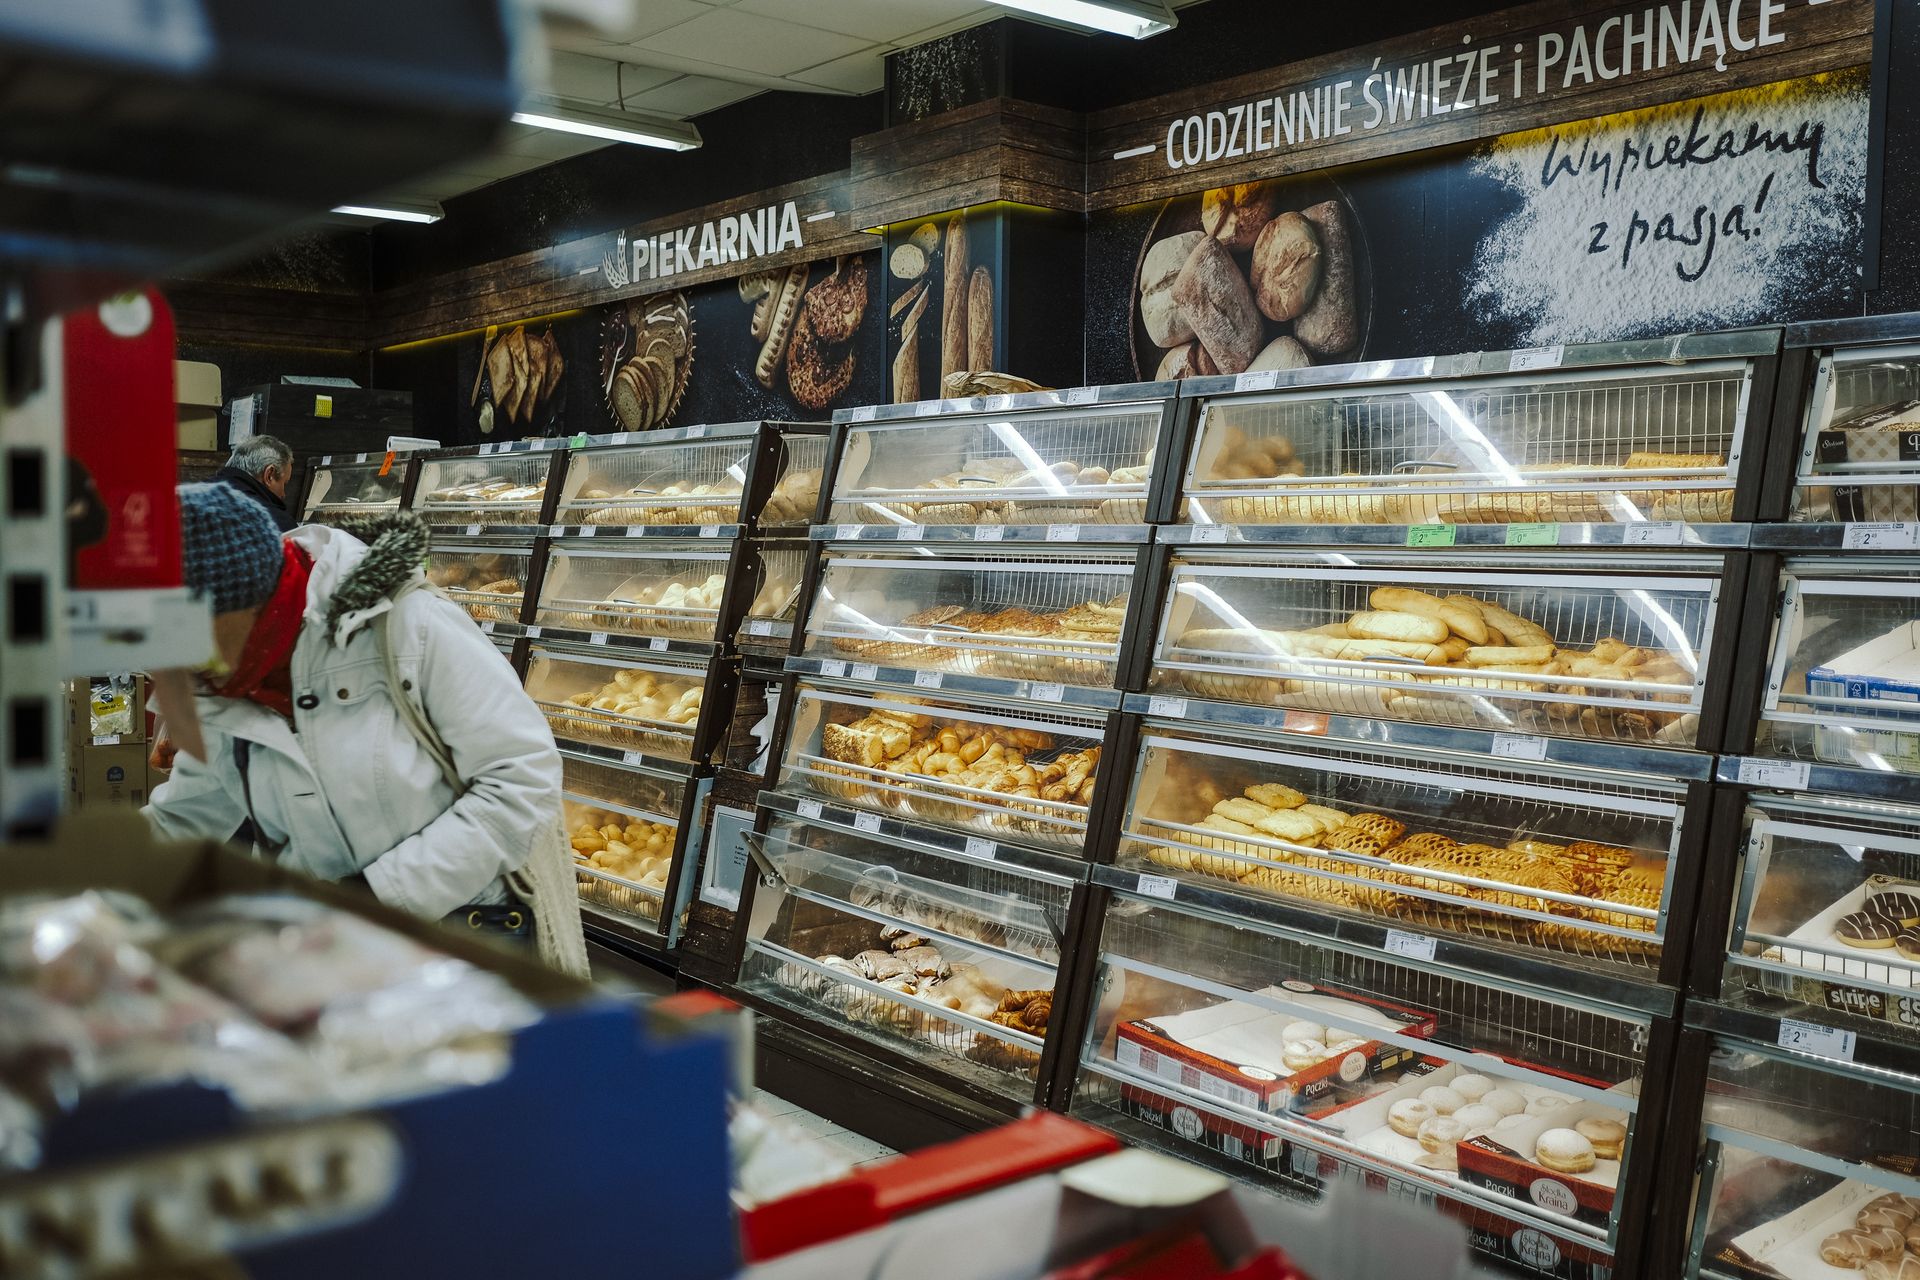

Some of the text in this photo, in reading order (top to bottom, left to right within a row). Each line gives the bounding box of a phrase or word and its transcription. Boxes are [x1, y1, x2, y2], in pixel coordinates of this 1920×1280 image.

[1165, 0, 1786, 170] CODZIENNIE ŚWIEŻE i PACHNĄCE
[1541, 105, 1826, 201] Wypiekamy
[633, 201, 803, 283] PIEKARNIA
[1587, 176, 1773, 283] z pasja!
[1863, 533, 1871, 545] 2
[1793, 1031, 1801, 1043] 2
[1538, 1191, 1568, 1211] Kraina
